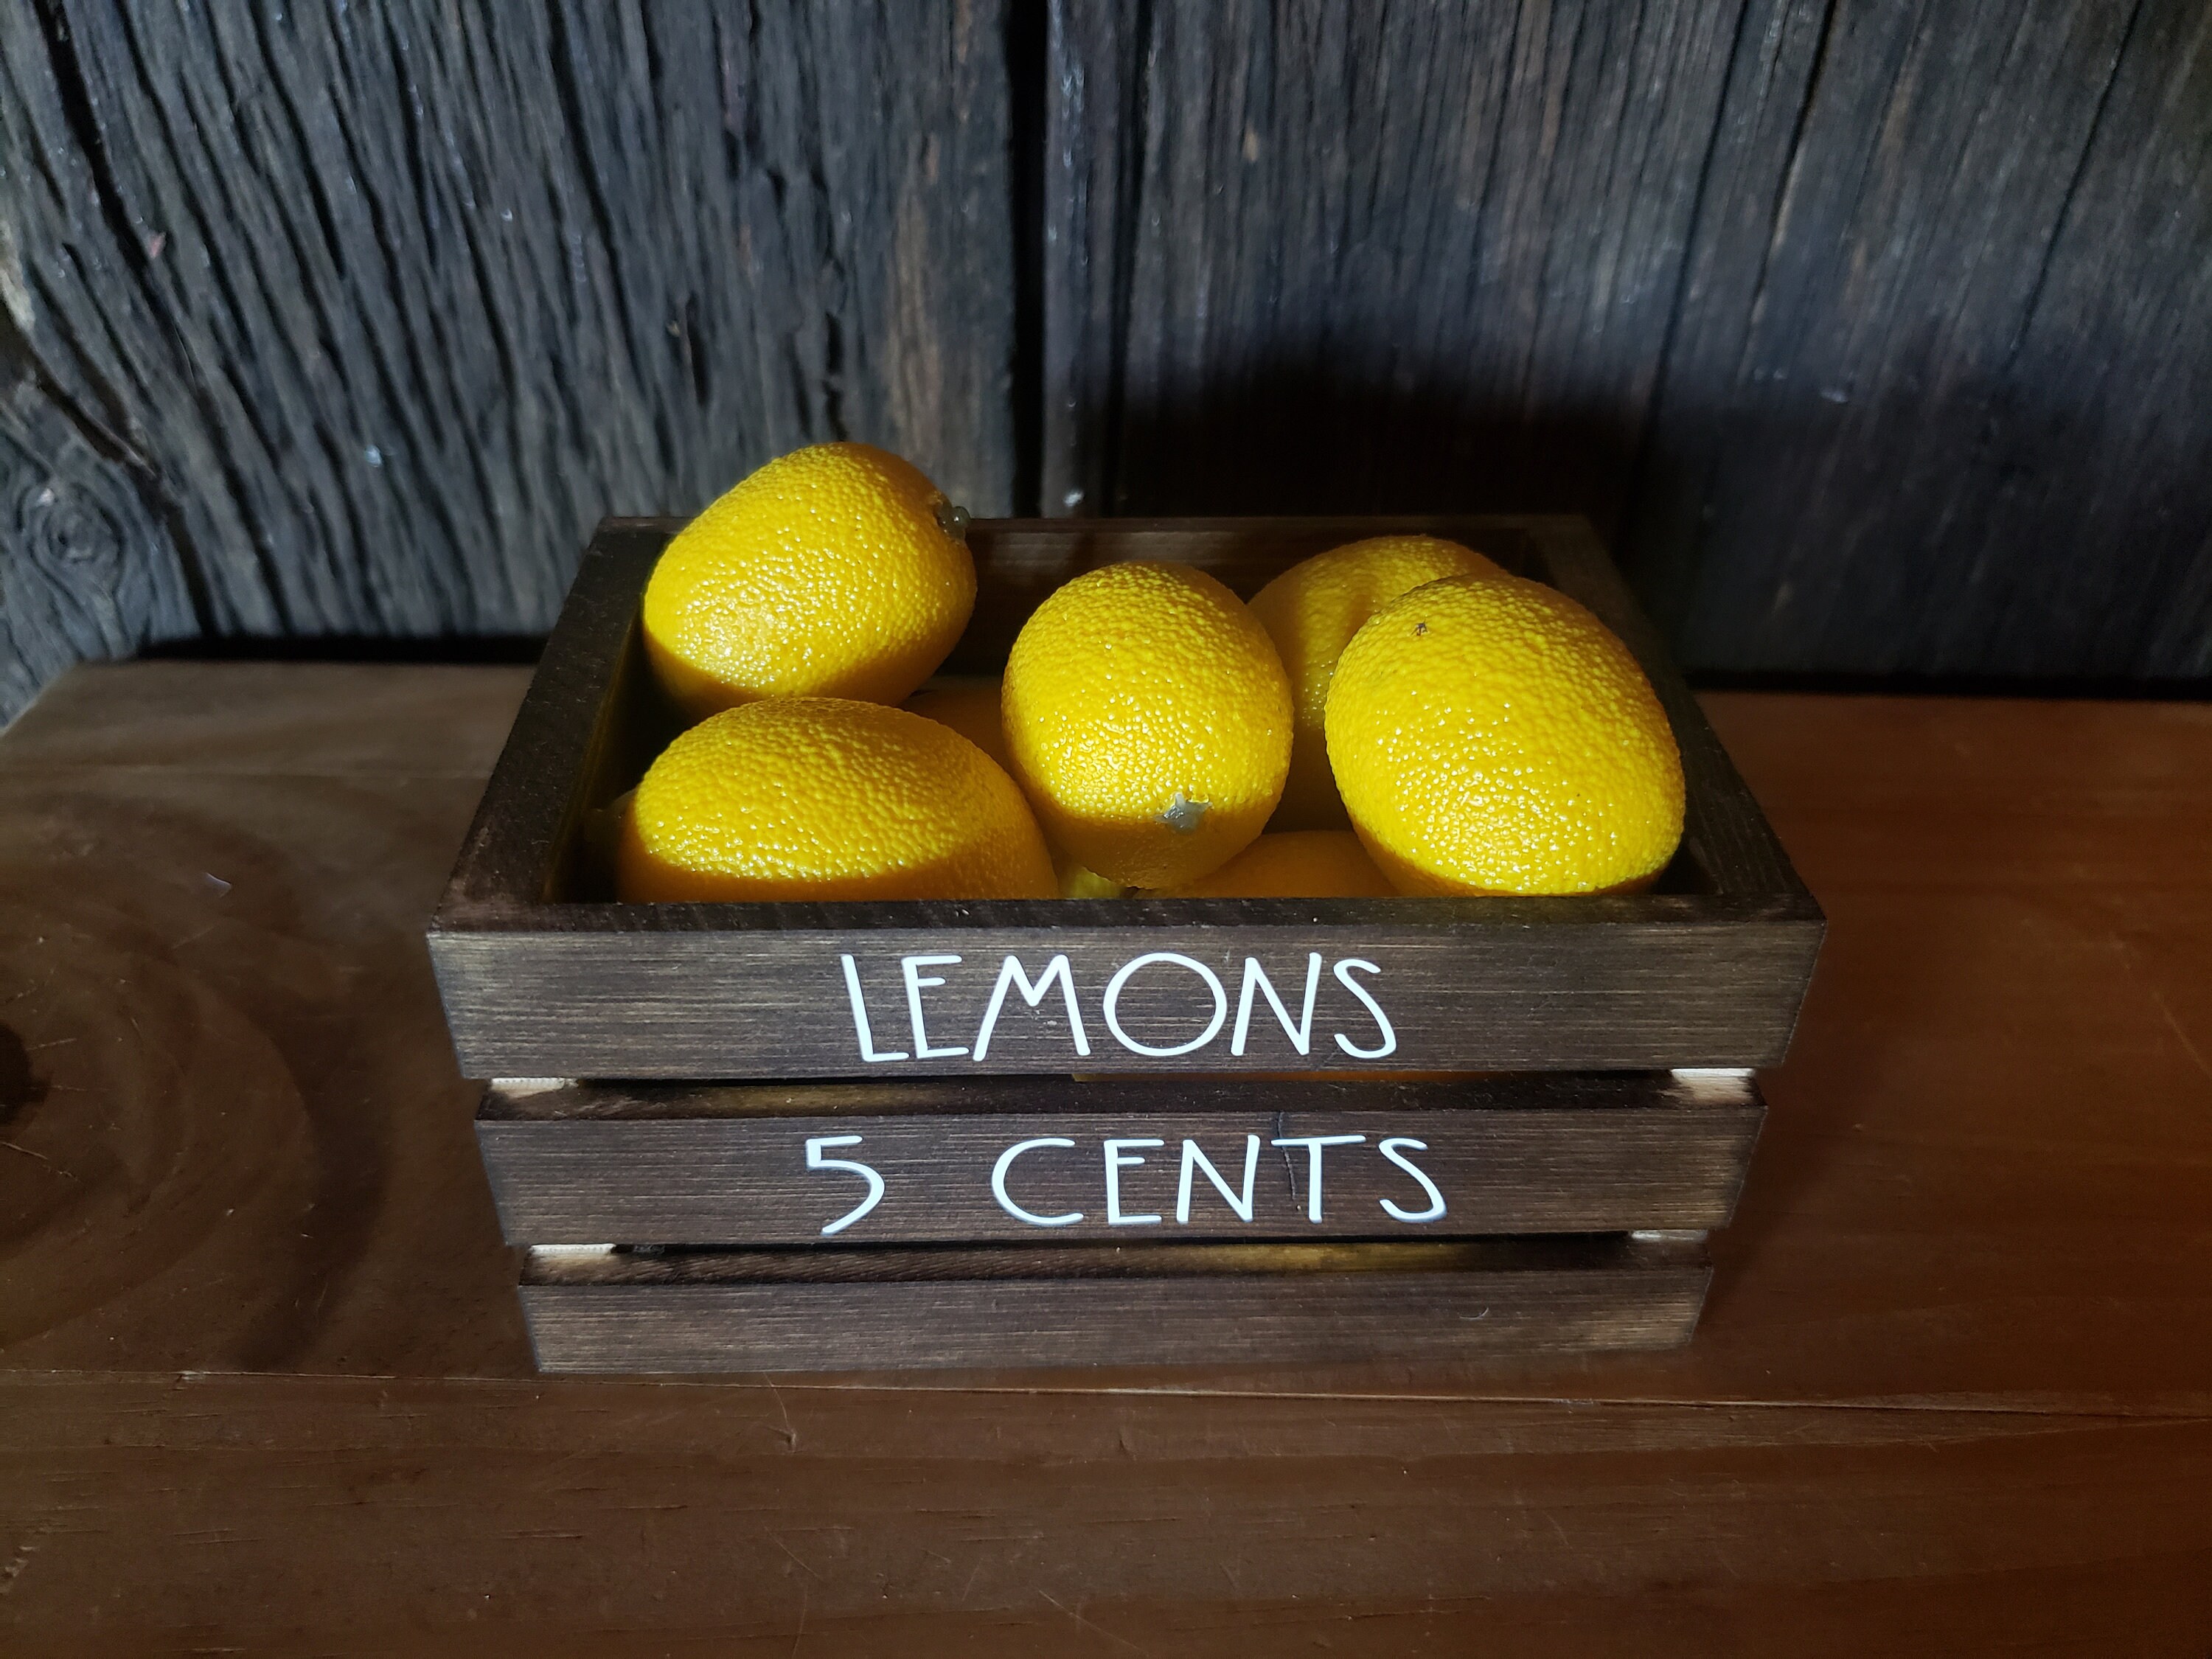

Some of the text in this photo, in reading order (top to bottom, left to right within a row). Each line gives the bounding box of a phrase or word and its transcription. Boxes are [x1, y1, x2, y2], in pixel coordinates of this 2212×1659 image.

[839, 951, 1396, 1062] LEMONS
[805, 1135, 1446, 1237] 5 CENTS
